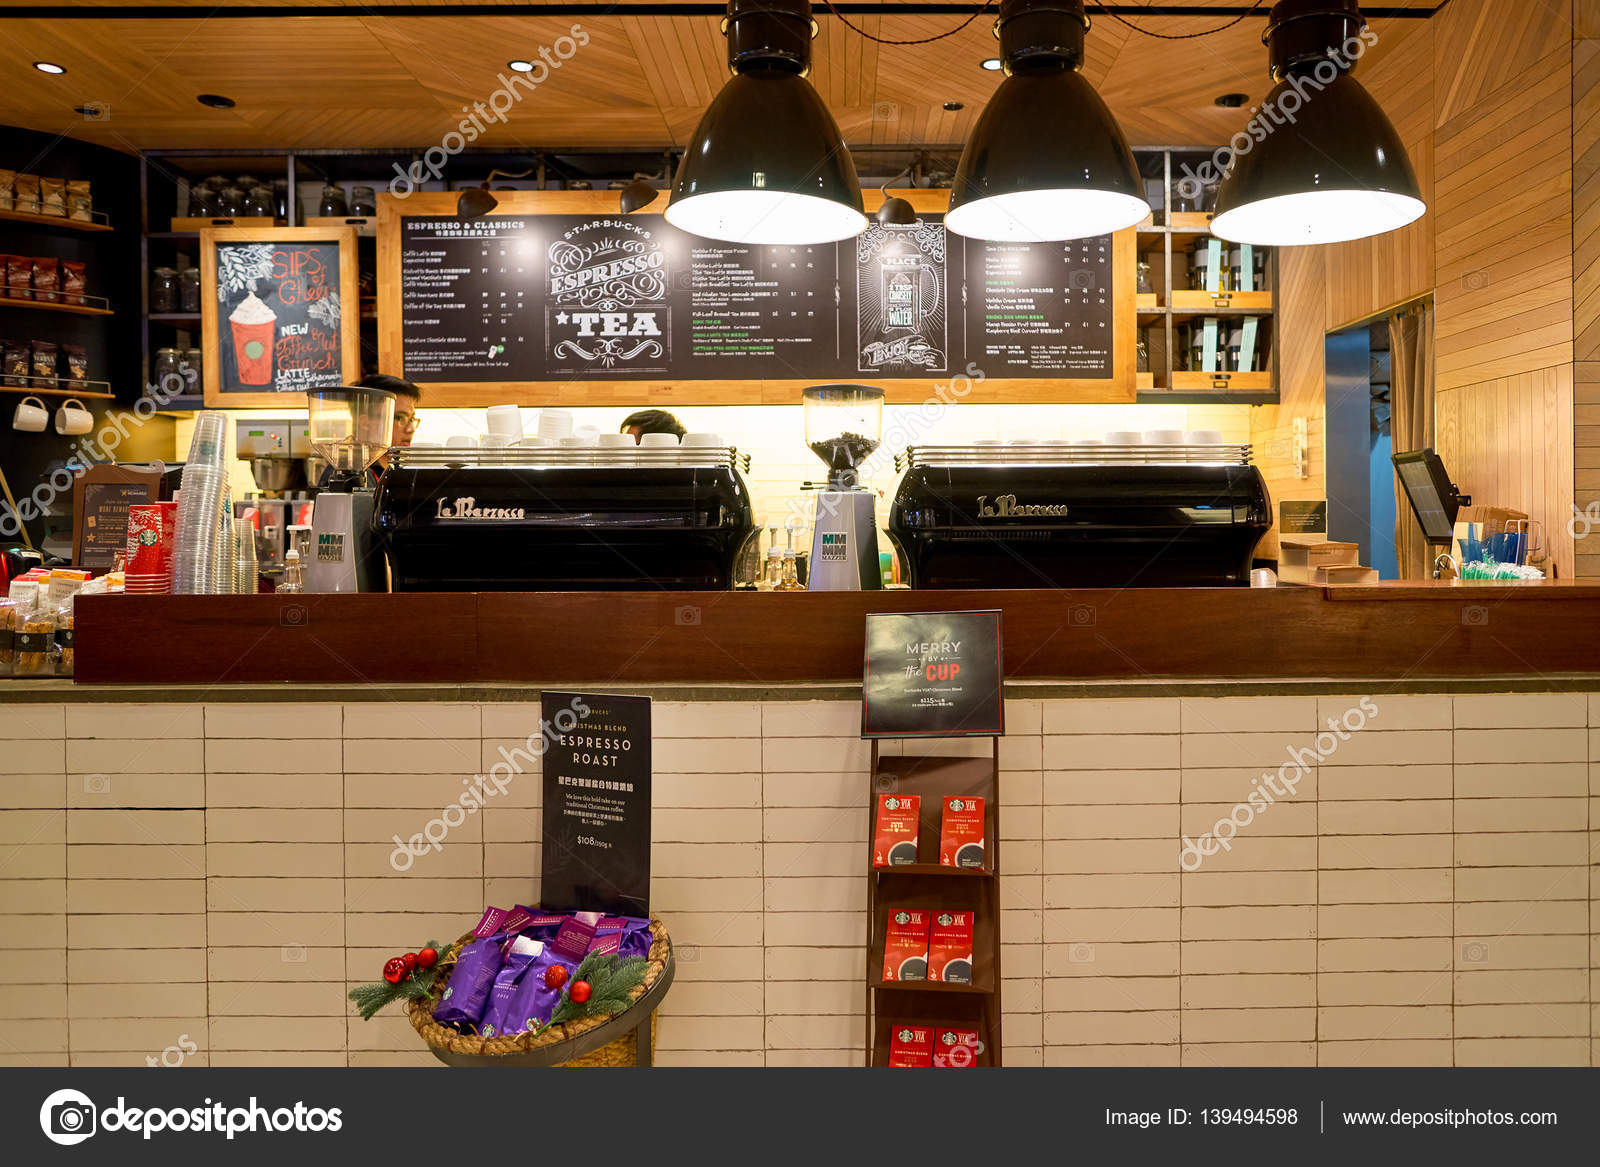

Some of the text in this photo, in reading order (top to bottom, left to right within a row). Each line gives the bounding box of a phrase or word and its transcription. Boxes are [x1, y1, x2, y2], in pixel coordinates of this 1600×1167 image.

[407, 222, 460, 230] ESPRESSO
[474, 221, 526, 230] CLASSICS
[272, 248, 322, 279] SIPS
[550, 251, 664, 295] ESPRESSO
[572, 312, 662, 337] TEA
[889, 311, 913, 326] WATER
[281, 323, 309, 336] NEW
[277, 367, 310, 379] LATTE
[822, 534, 846, 545] MM
[906, 641, 961, 654] MERRY
[904, 663, 961, 681] the CUP
[563, 722, 627, 732] CHRISTMAS BLEND
[560, 735, 631, 751] ESPRESSO
[573, 752, 618, 767] ROAST
[900, 799, 912, 808] VIA
[965, 800, 977, 809] VIA
